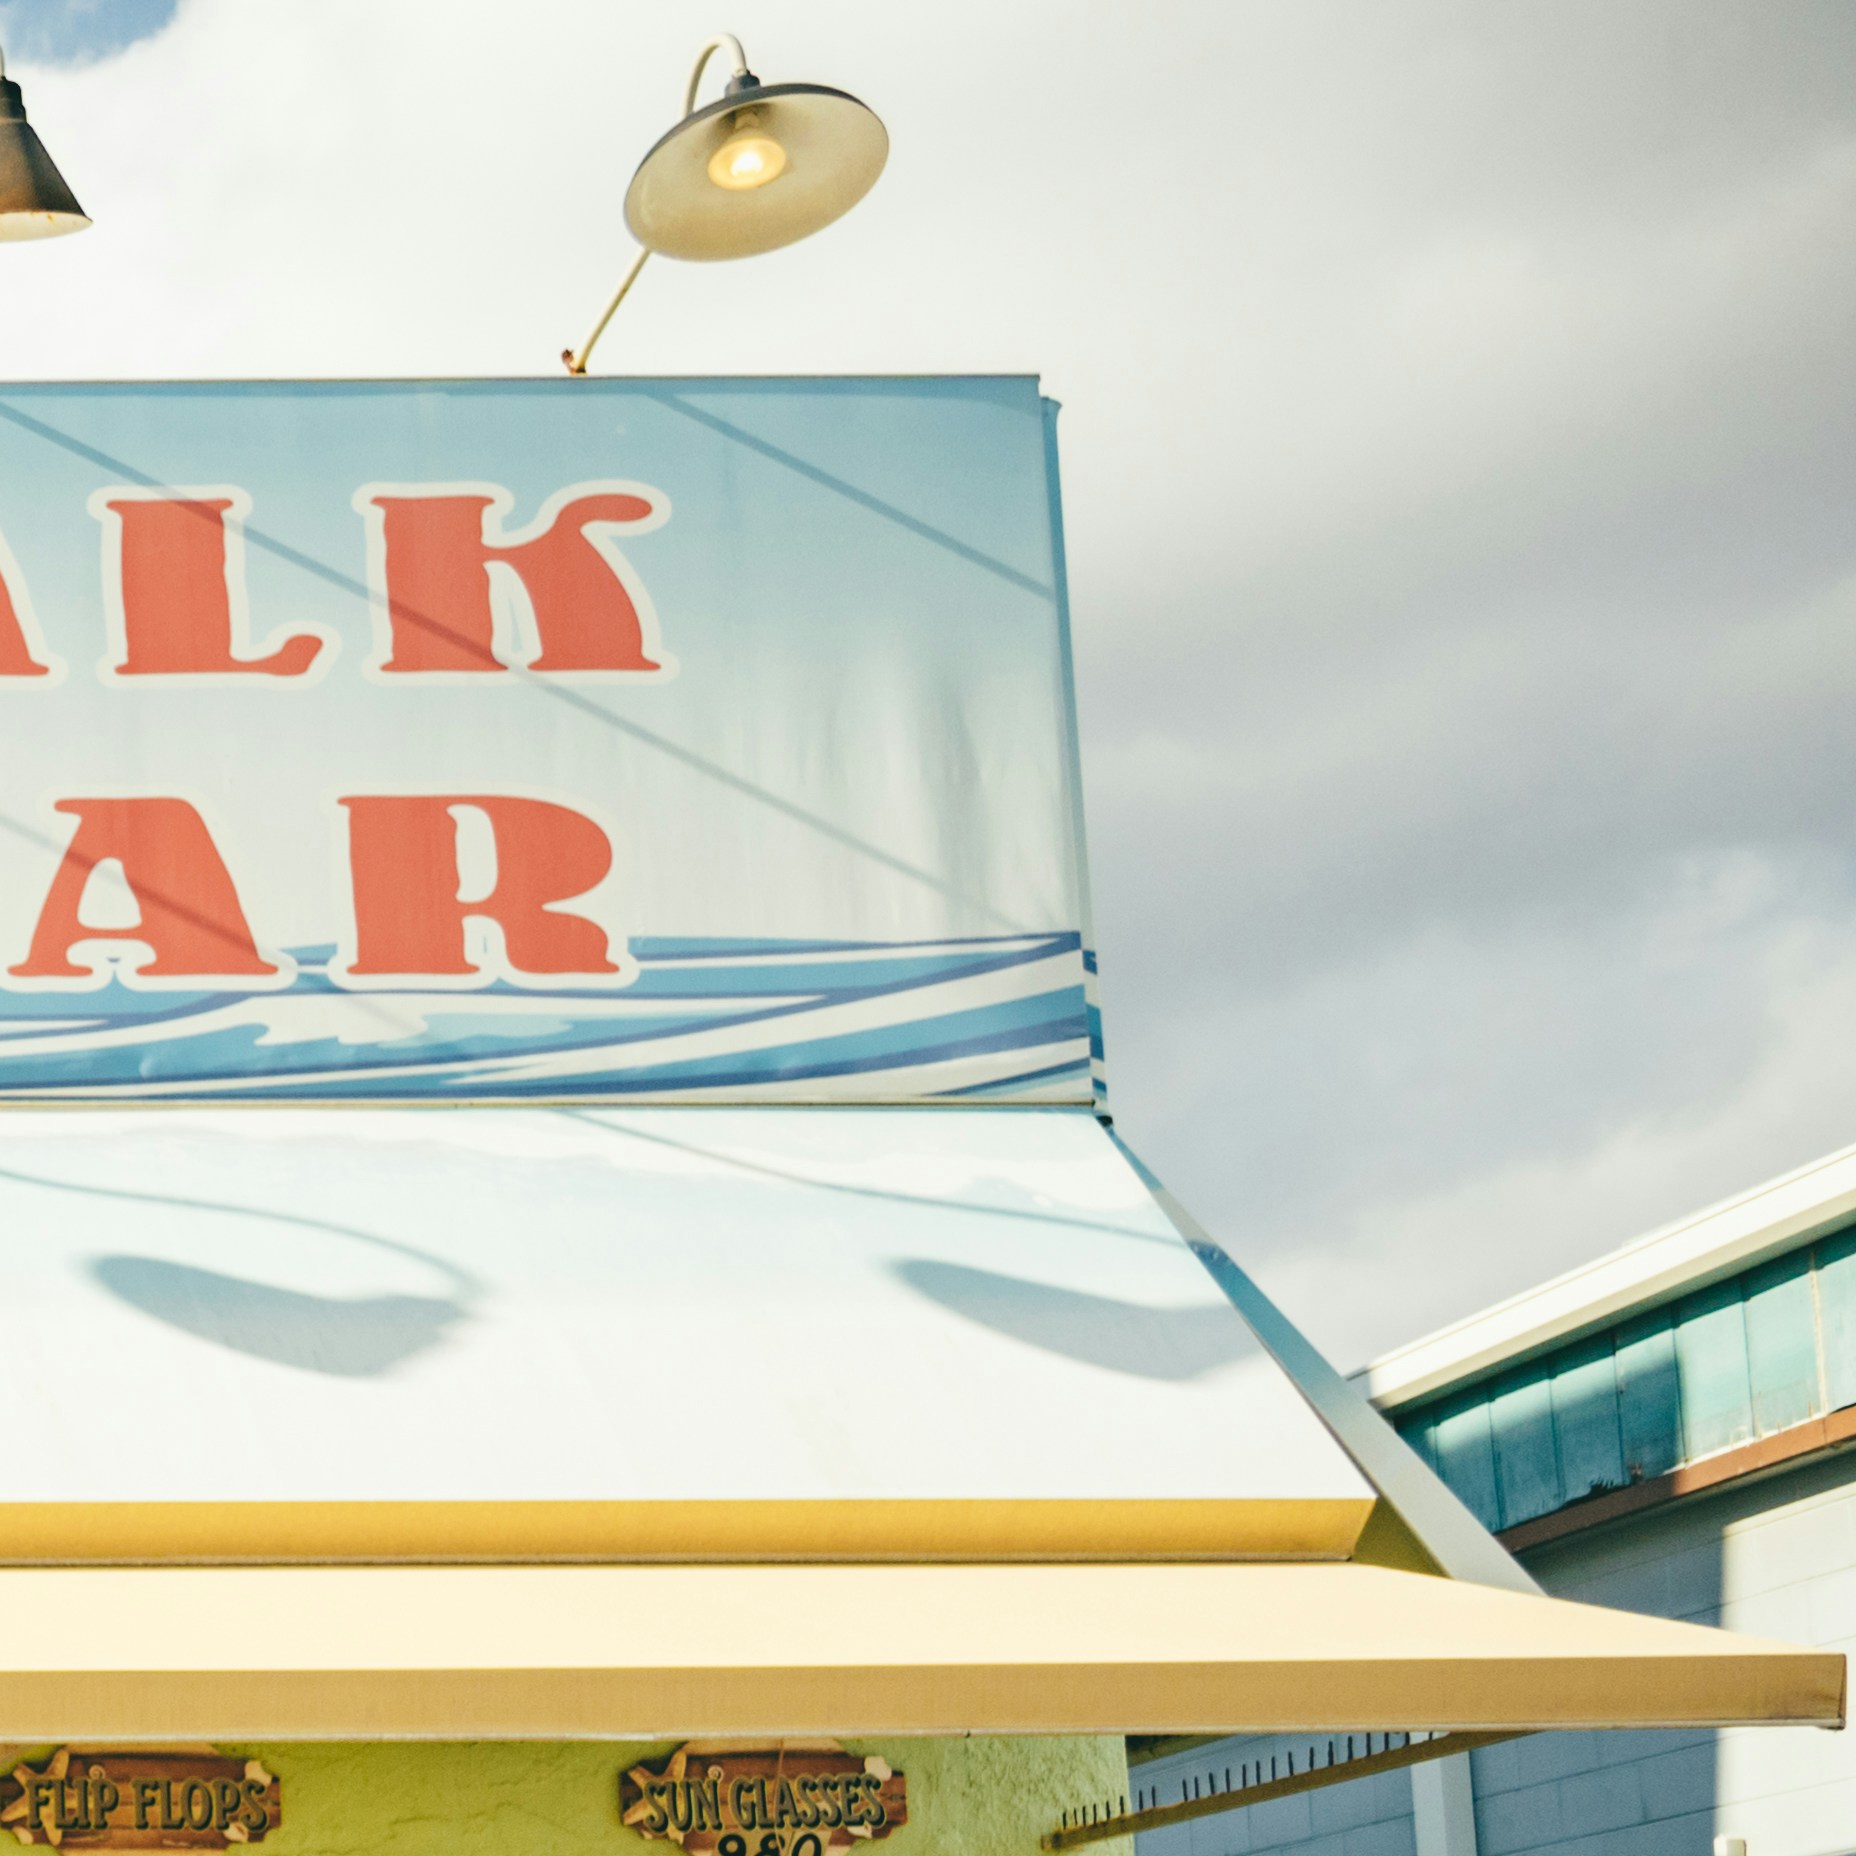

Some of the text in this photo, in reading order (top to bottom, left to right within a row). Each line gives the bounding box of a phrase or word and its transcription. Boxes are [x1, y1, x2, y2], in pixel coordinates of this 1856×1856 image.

[26, 1776, 269, 1832] FLIP FLOPS
[642, 1773, 887, 1833] SUN GLASSES
